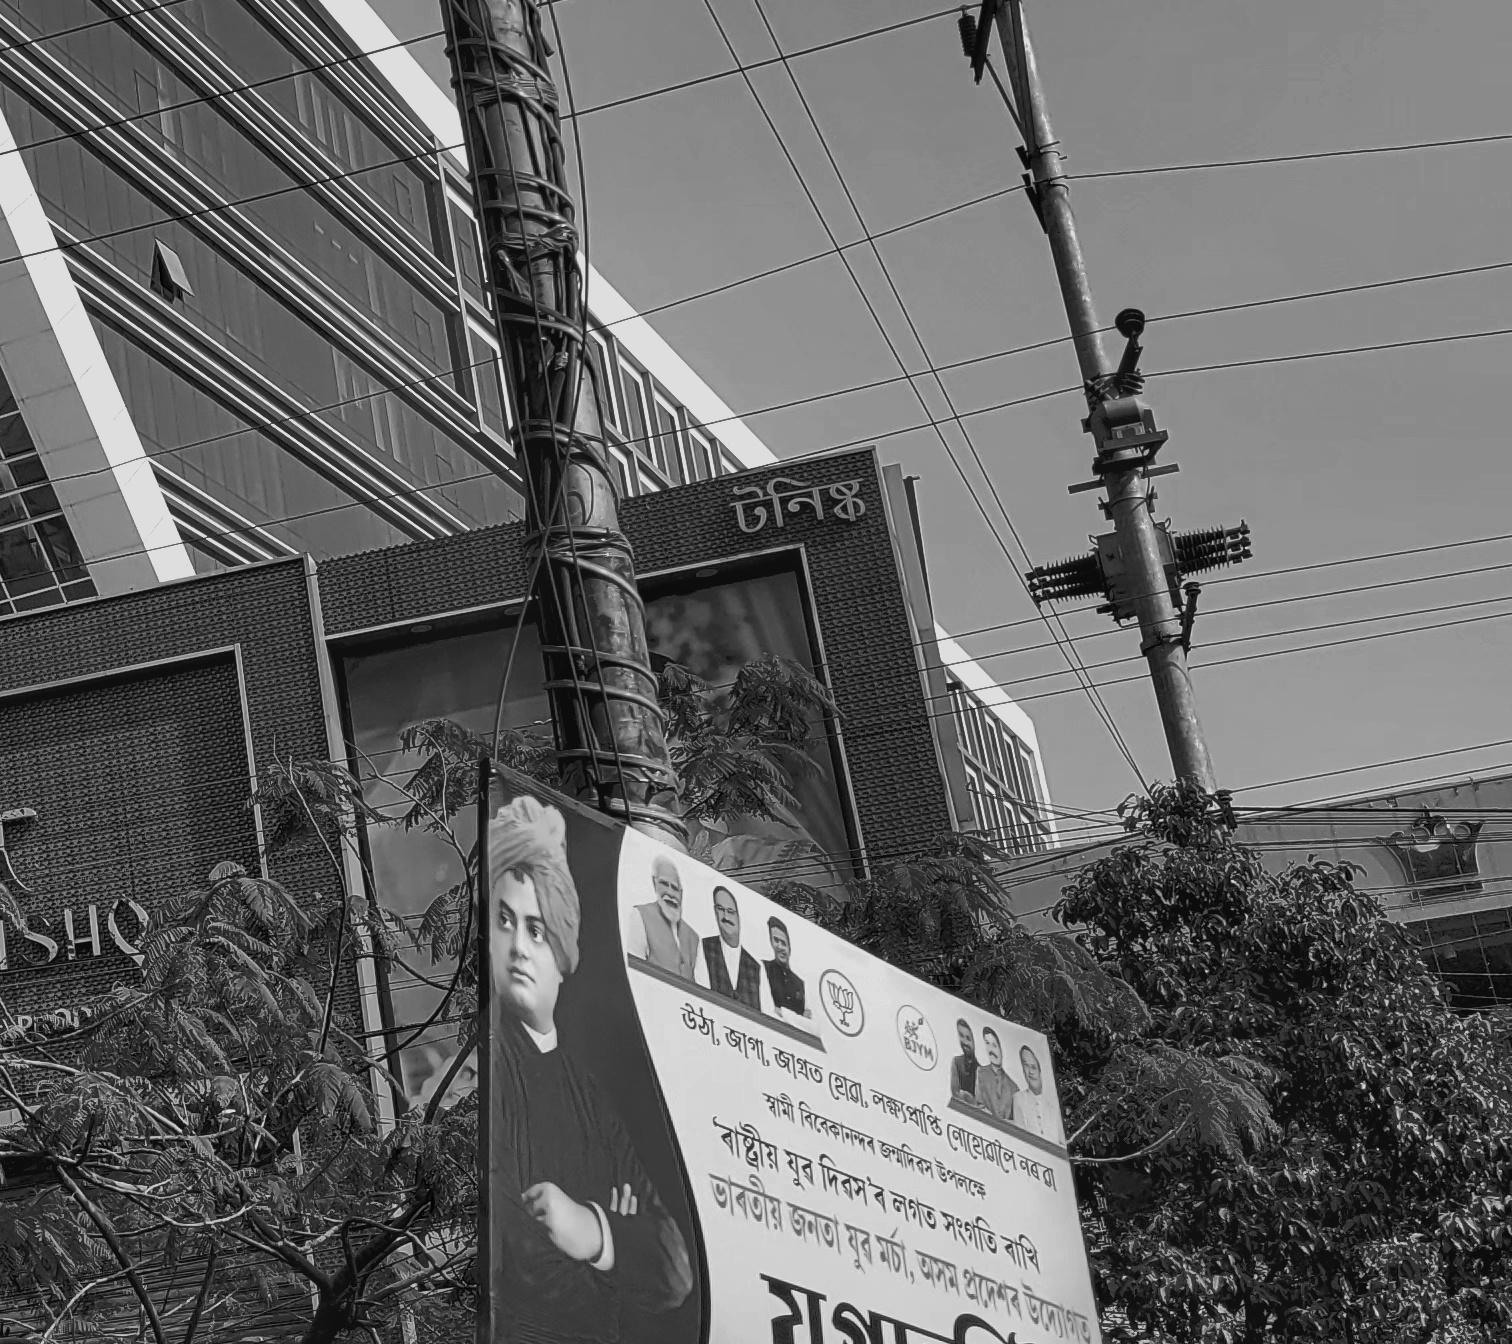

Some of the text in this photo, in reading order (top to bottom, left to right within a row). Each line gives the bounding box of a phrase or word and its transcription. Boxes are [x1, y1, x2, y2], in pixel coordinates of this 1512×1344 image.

[723, 1025, 770, 1067] জাগা,
[903, 1035, 934, 1062] BJYM
[786, 1201, 842, 1256] জনতা
[914, 1249, 960, 1297] অসম
[888, 1189, 937, 1230] লগত
[939, 1215, 999, 1255] সংগতি
